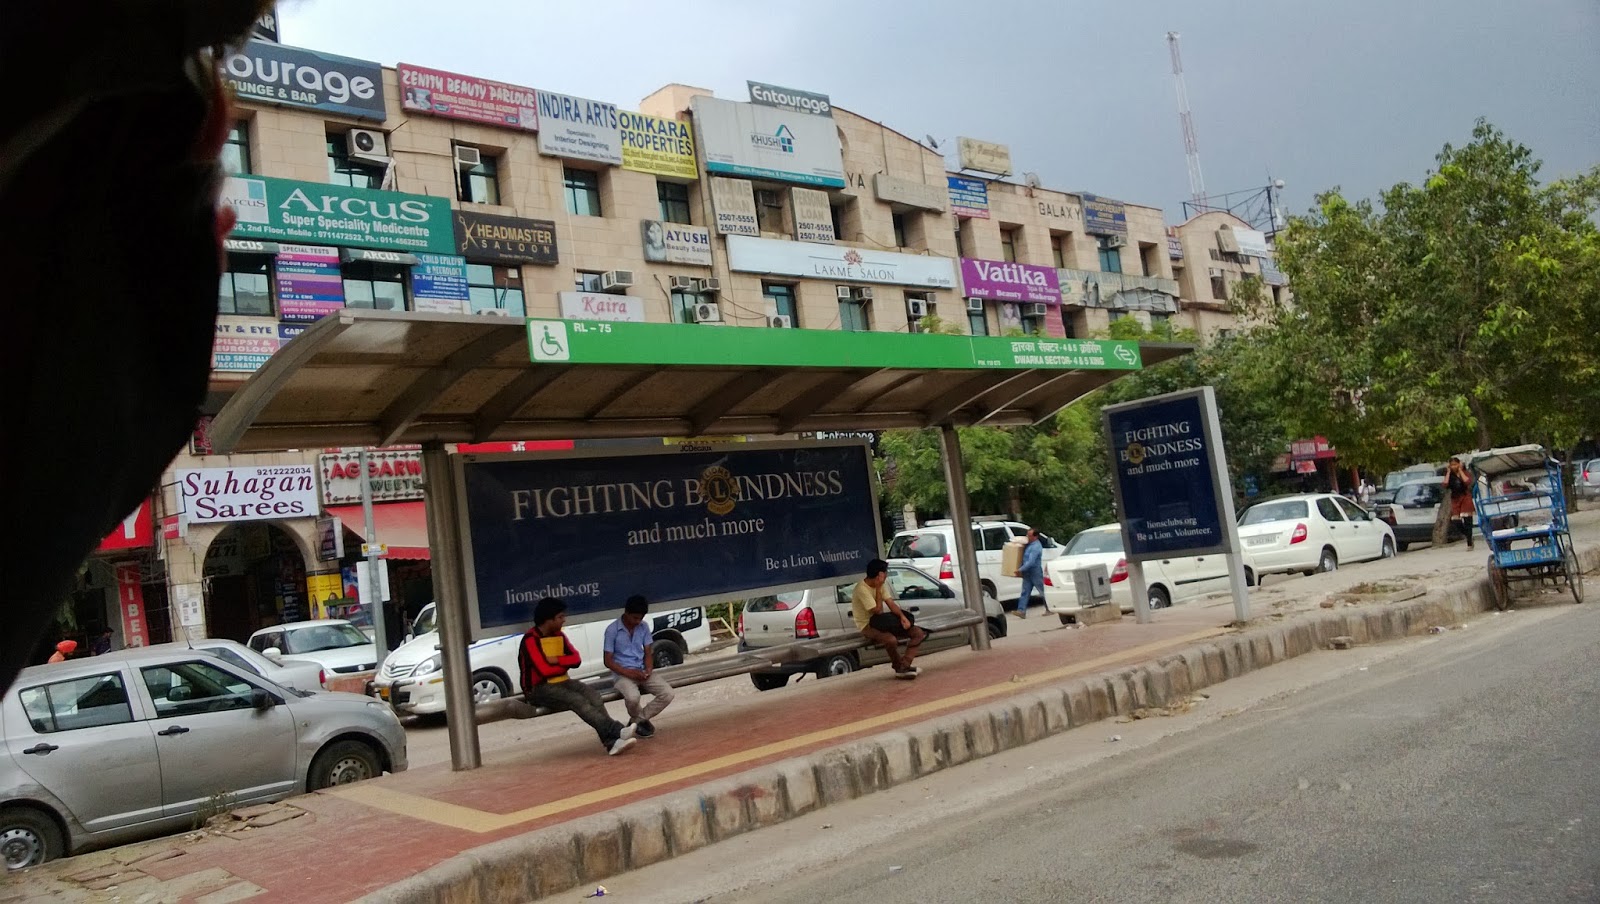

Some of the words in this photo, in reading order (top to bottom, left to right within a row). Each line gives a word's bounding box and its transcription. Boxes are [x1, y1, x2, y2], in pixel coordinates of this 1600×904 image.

[278, 89, 288, 99] &
[291, 90, 317, 104] BAR
[402, 69, 444, 93] ZENITY
[447, 77, 487, 100] BEAUTY
[490, 85, 535, 108] PARLOUR
[752, 85, 830, 114] Entourage
[537, 91, 583, 123] INDIRA
[586, 101, 617, 129] ARTS
[619, 112, 690, 139] OMKARA
[554, 134, 577, 144] Interior
[578, 138, 609, 151] Designing
[621, 129, 693, 156] PROPERTIES
[751, 134, 781, 148] KHUSHI
[718, 213, 755, 224] 2507-5555
[1039, 201, 1081, 221] GALAXY
[247, 223, 262, 232] 2nd
[264, 225, 286, 235] Floor,
[287, 228, 312, 237] Mobile
[282, 211, 315, 228] Super
[318, 215, 370, 234] Speciality
[373, 221, 429, 237] Medicentre
[720, 223, 756, 234] 2507-5551
[798, 221, 833, 232] 2507-5555
[477, 223, 552, 244] HEADMASTER
[666, 229, 709, 245] AYUSH
[800, 232, 834, 242] 2507-5551
[282, 246, 309, 254] SPECIAL
[310, 247, 330, 255] TESTS
[481, 239, 550, 255] SALOON
[666, 243, 690, 252] Beauty
[691, 245, 710, 253] Salon
[363, 250, 400, 261] ARCUS
[815, 264, 853, 278] LAKME
[860, 267, 895, 280] SALON
[973, 260, 1048, 286] Vatika
[971, 287, 989, 296] Hair
[996, 289, 1022, 300] Beauty
[582, 296, 627, 316] Kaira
[235, 325, 245, 333] &
[250, 325, 272, 334] EYE
[573, 322, 589, 333] RL
[598, 323, 612, 333] 75
[1010, 341, 1036, 353] द्वारका
[1014, 355, 1045, 365] DWARKA
[1089, 356, 1105, 366] XING
[1125, 421, 1191, 443] FIGHTING
[680, 444, 712, 452] JCDecaux
[256, 467, 311, 476] 9212222034
[1127, 463, 1144, 476] and
[1146, 459, 1172, 473] much
[1174, 457, 1200, 469] more
[184, 470, 313, 500] Suhagan
[195, 497, 304, 519] Sarees
[512, 480, 676, 521] FIGHTING
[628, 523, 660, 546] and
[666, 519, 717, 543] much
[721, 516, 765, 535] more
[1146, 516, 1198, 530] lionsclubs.org
[1136, 532, 1147, 541] Be
[1154, 529, 1173, 540] Lion.
[1174, 526, 1213, 538] Volunteer.
[765, 557, 780, 571] Be
[782, 560, 788, 569] a
[790, 553, 818, 568] Lion.
[505, 582, 600, 605] lionsclubs.org
[667, 608, 700, 628] SPEED
